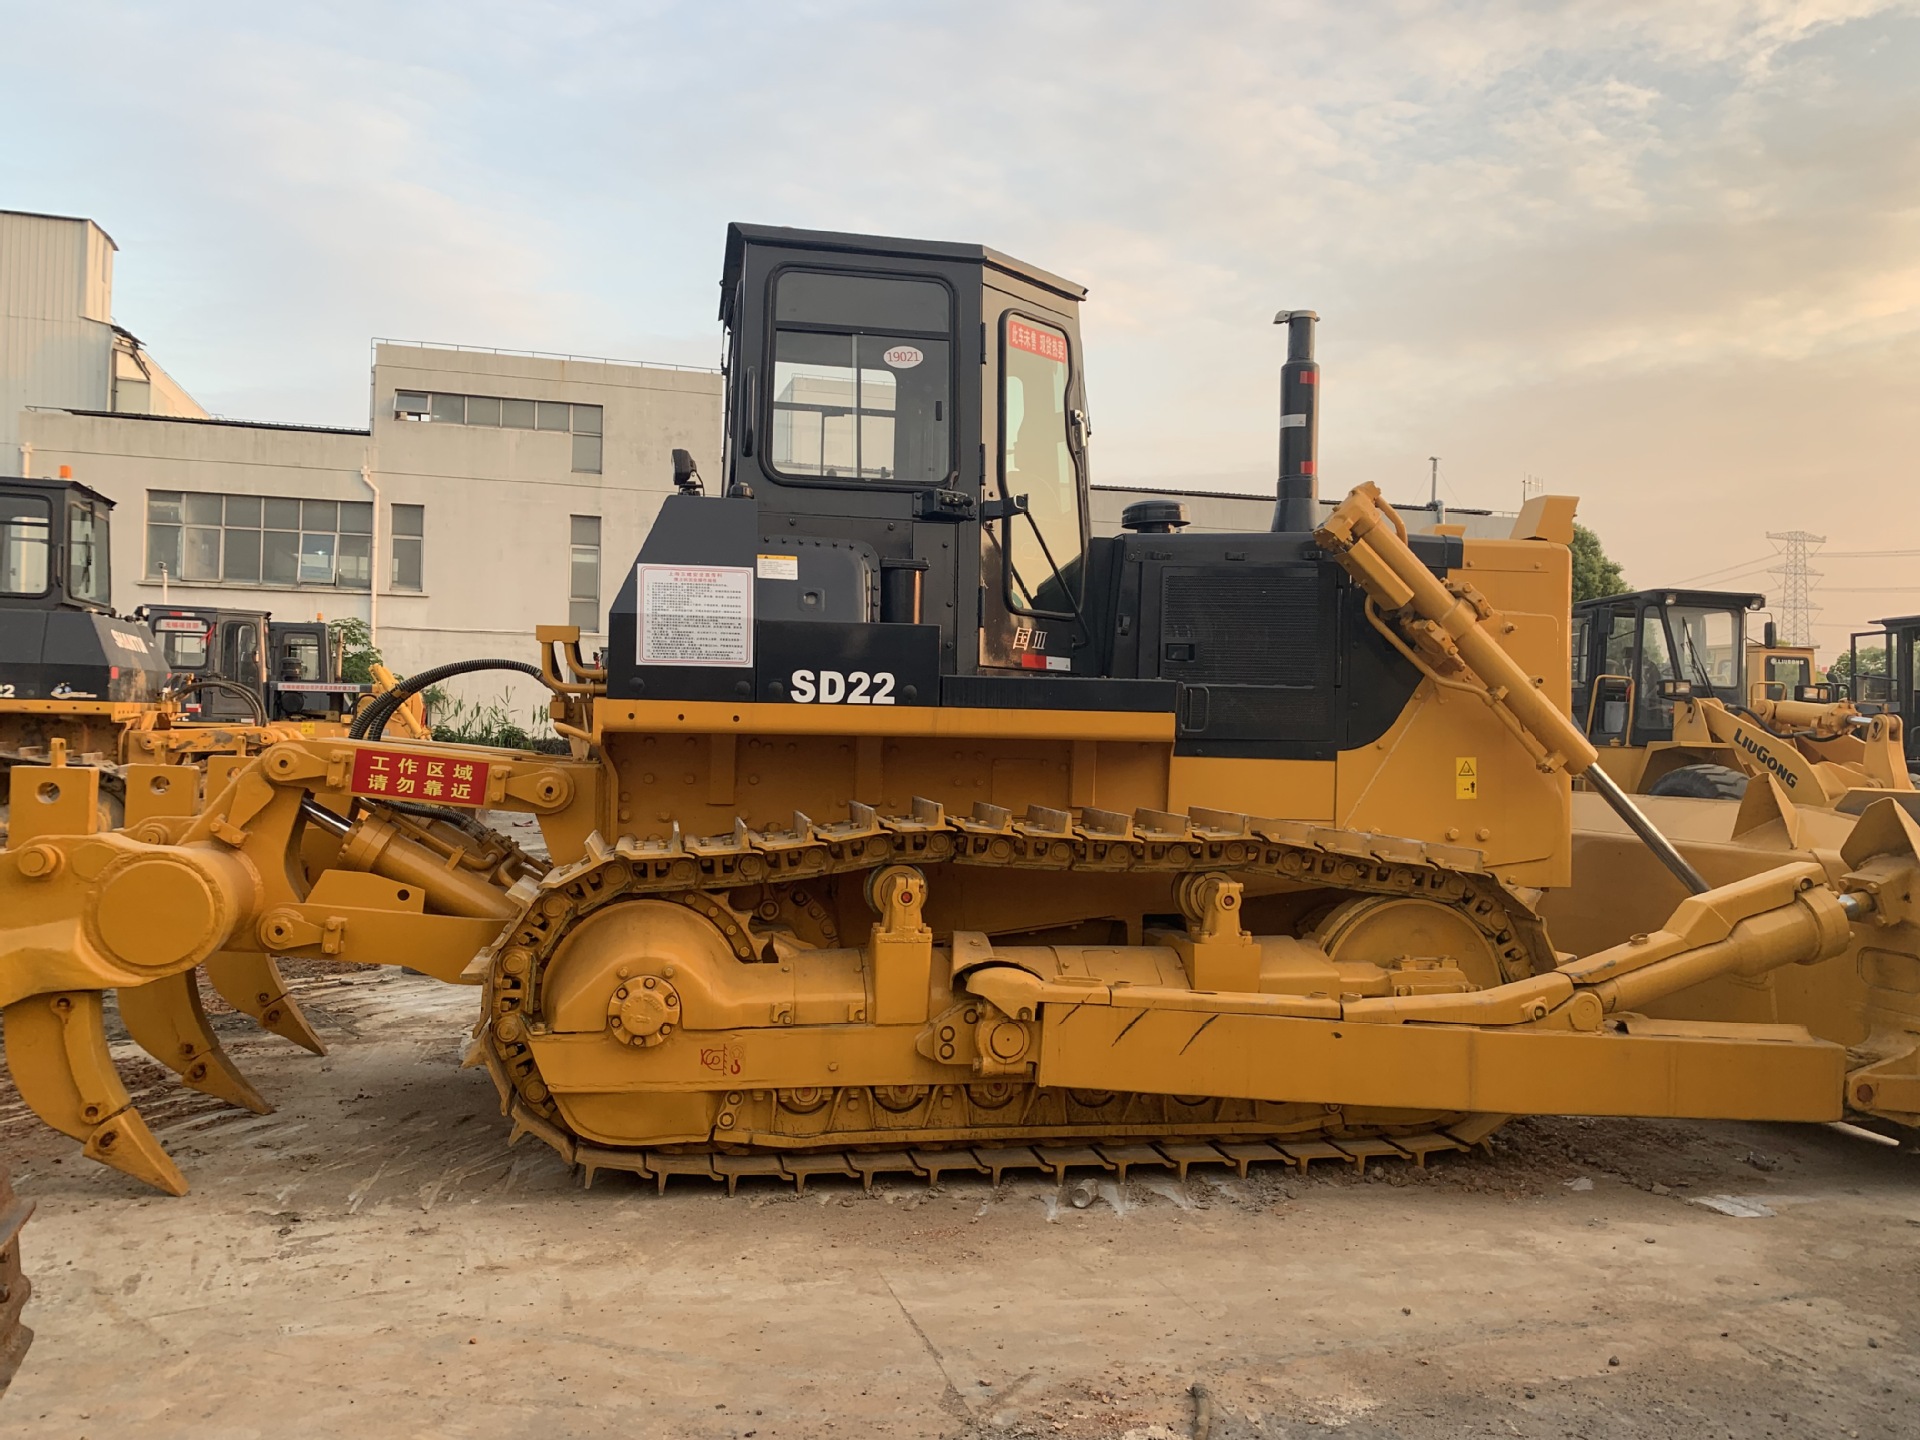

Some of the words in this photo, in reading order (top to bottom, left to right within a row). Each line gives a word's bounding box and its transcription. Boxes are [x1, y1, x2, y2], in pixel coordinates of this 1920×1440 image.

[887, 351, 920, 362] 19021
[790, 669, 895, 704] SD22
[370, 756, 474, 781] 工作区域
[367, 774, 471, 799] 请勿靠近
